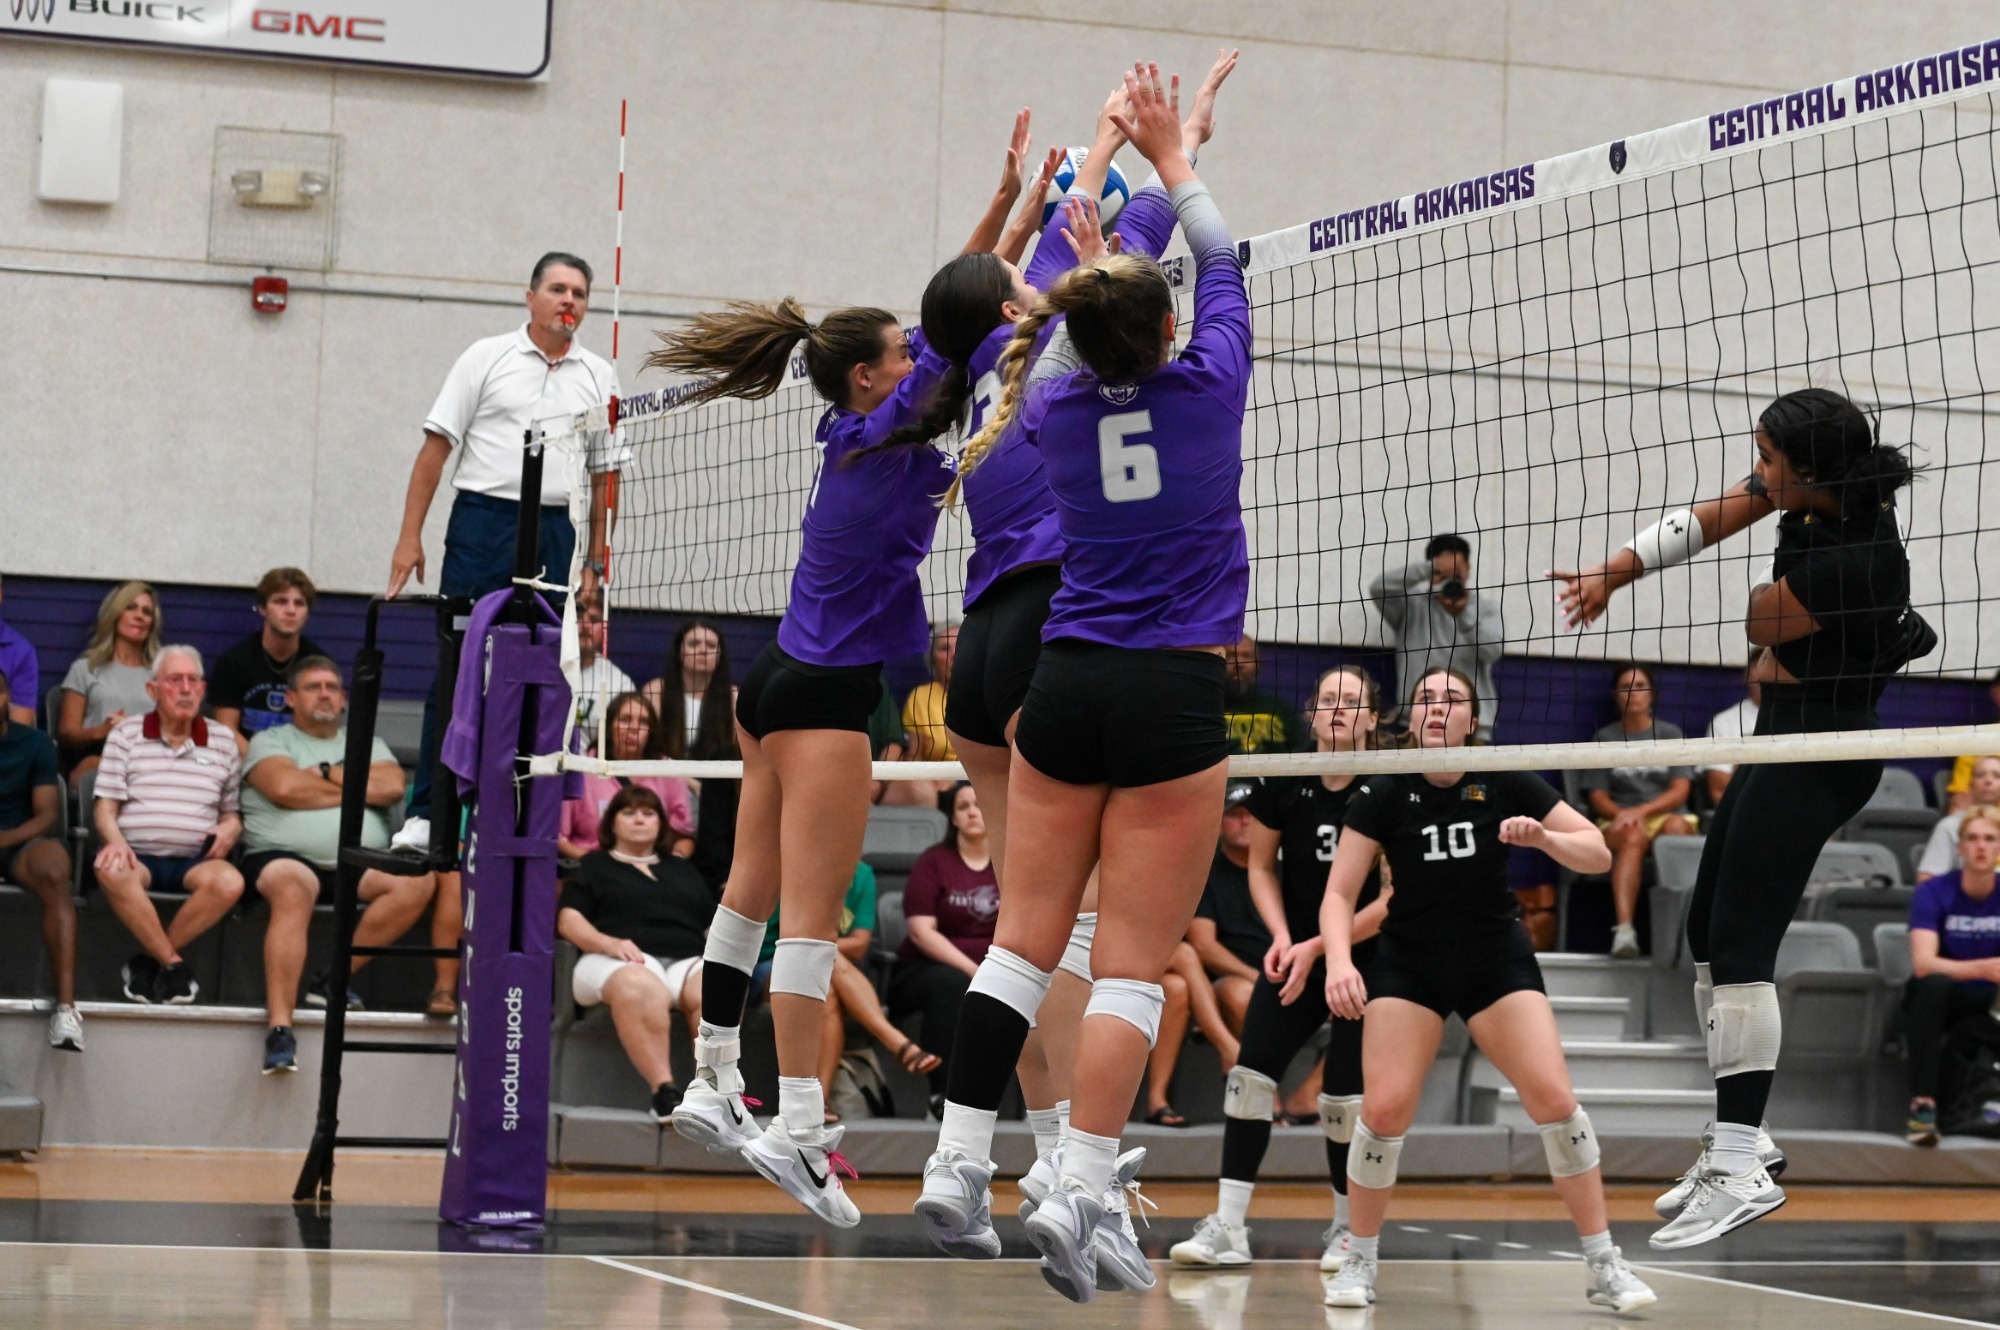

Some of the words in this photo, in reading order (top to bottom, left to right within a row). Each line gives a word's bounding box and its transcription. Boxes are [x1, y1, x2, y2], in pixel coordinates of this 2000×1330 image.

[69, 0, 206, 23] BUICK
[252, 9, 385, 42] GMC
[1709, 83, 1846, 151] CENTRAL
[1309, 199, 1408, 252] CENTRAL
[1414, 163, 1535, 225] ARKANSAS
[618, 389, 660, 419] ENTRAL
[1098, 409, 1162, 503] 6
[1316, 824, 1338, 861] 3
[1421, 821, 1476, 861] 10
[504, 986, 523, 1050] sports
[501, 1053, 520, 1131] imports
